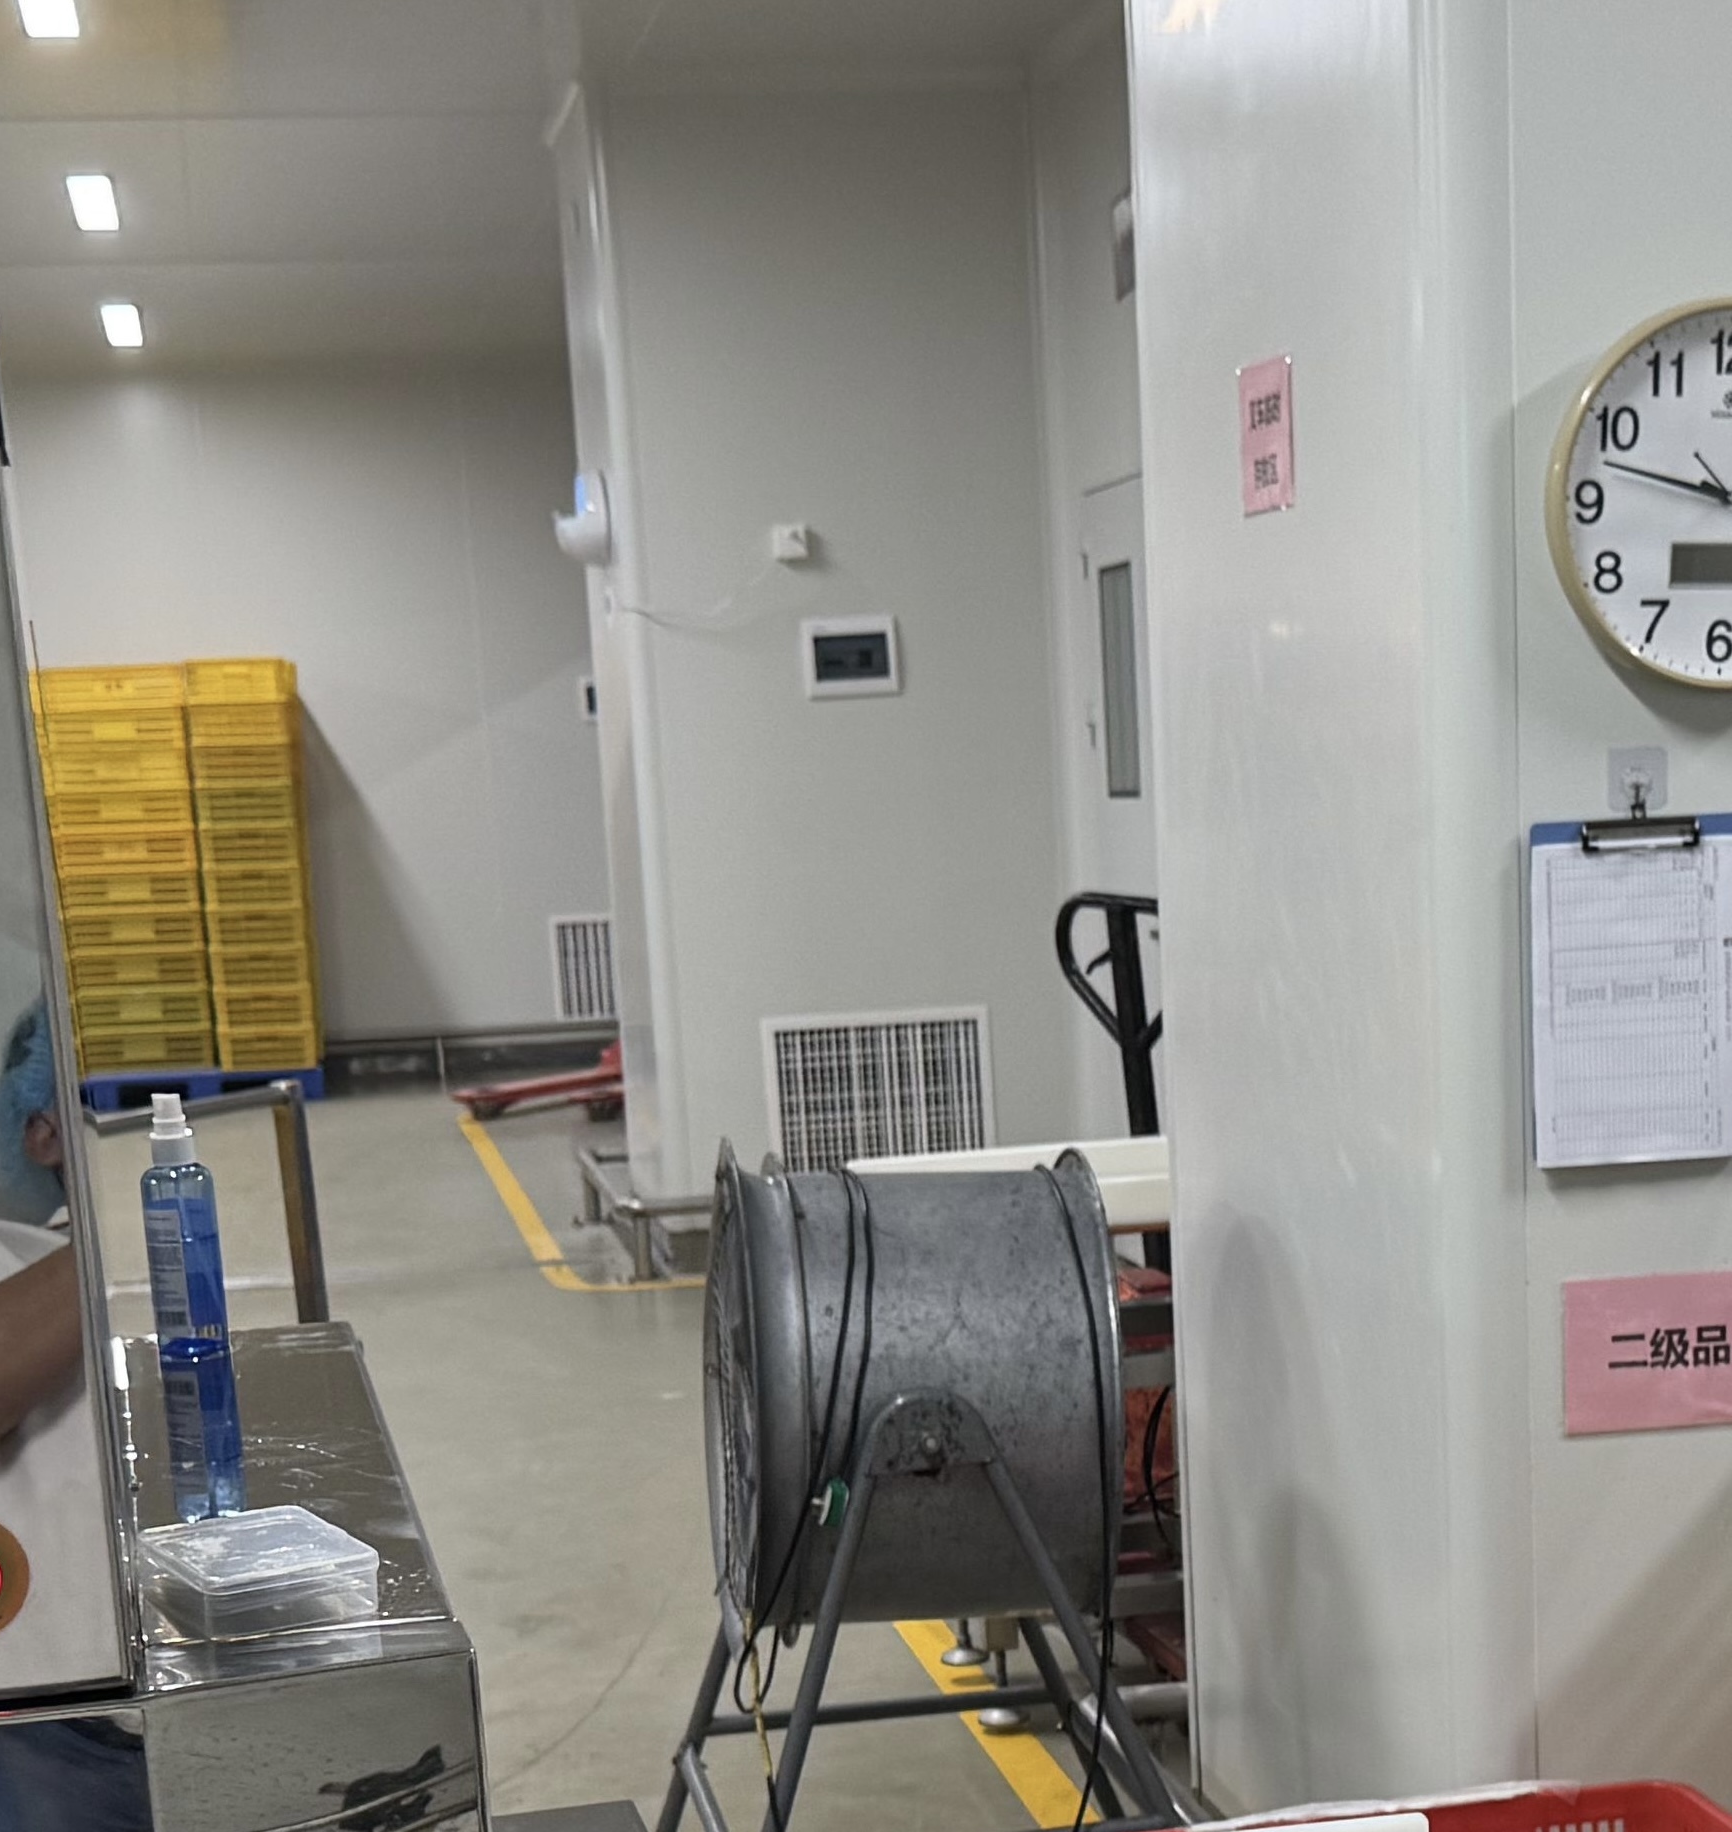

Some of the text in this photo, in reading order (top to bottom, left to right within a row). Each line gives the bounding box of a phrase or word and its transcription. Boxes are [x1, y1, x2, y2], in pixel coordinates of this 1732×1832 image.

[1647, 351, 1684, 397] 11
[1596, 406, 1640, 452] 10
[1574, 480, 1604, 524] 9
[1594, 551, 1623, 593] 8
[1640, 600, 1669, 643] 7
[1706, 620, 1732, 662] 6
[1609, 1324, 1731, 1370] 二级品
